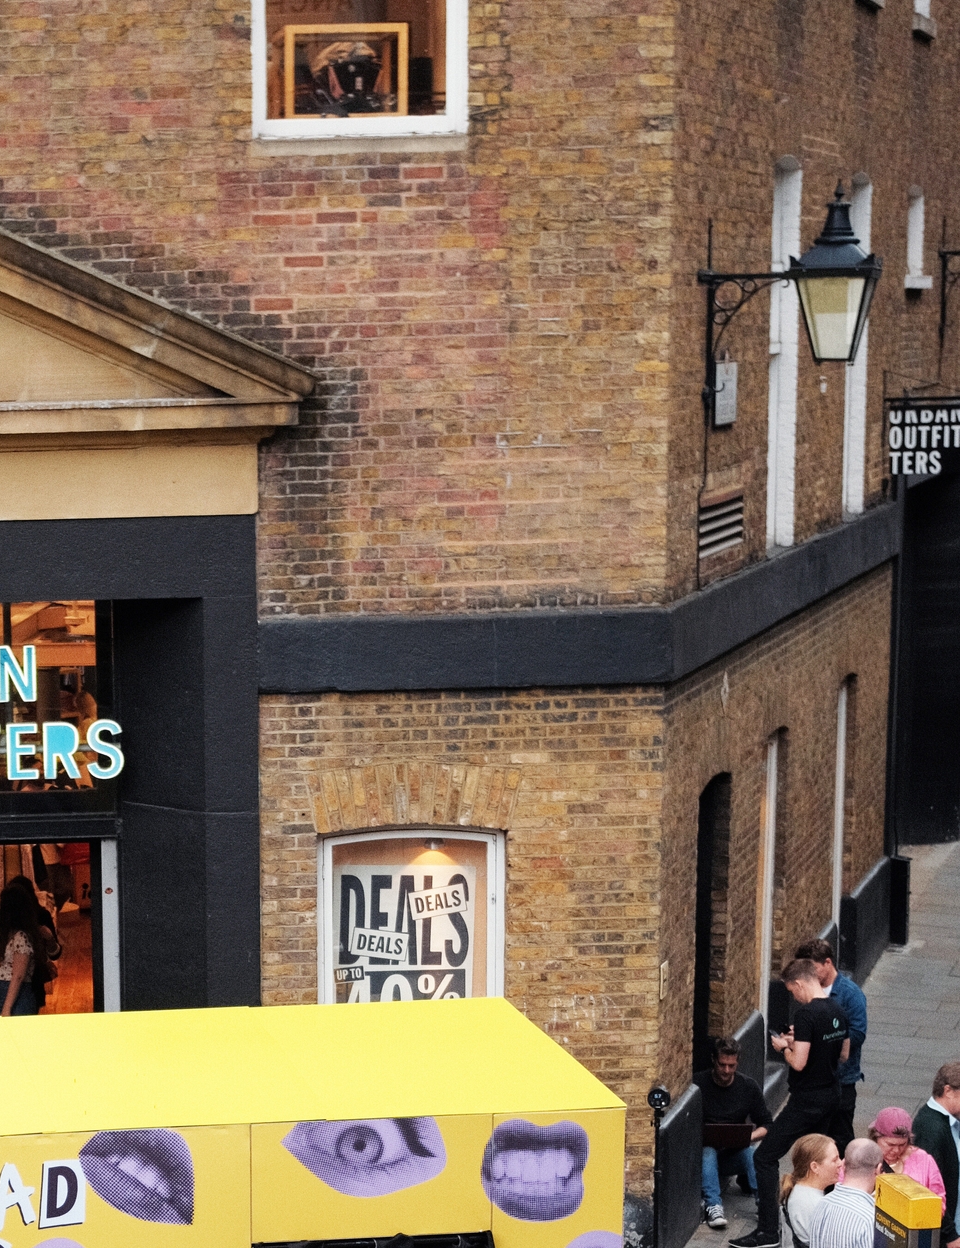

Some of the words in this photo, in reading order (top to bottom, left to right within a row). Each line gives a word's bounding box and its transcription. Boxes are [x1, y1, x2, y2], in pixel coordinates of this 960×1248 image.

[889, 450, 942, 475] TERS
[414, 889, 462, 914] DEALS
[338, 873, 470, 968] DEALS
[356, 933, 404, 955] DEALS
[336, 970, 349, 981] UP
[349, 968, 362, 979] TO
